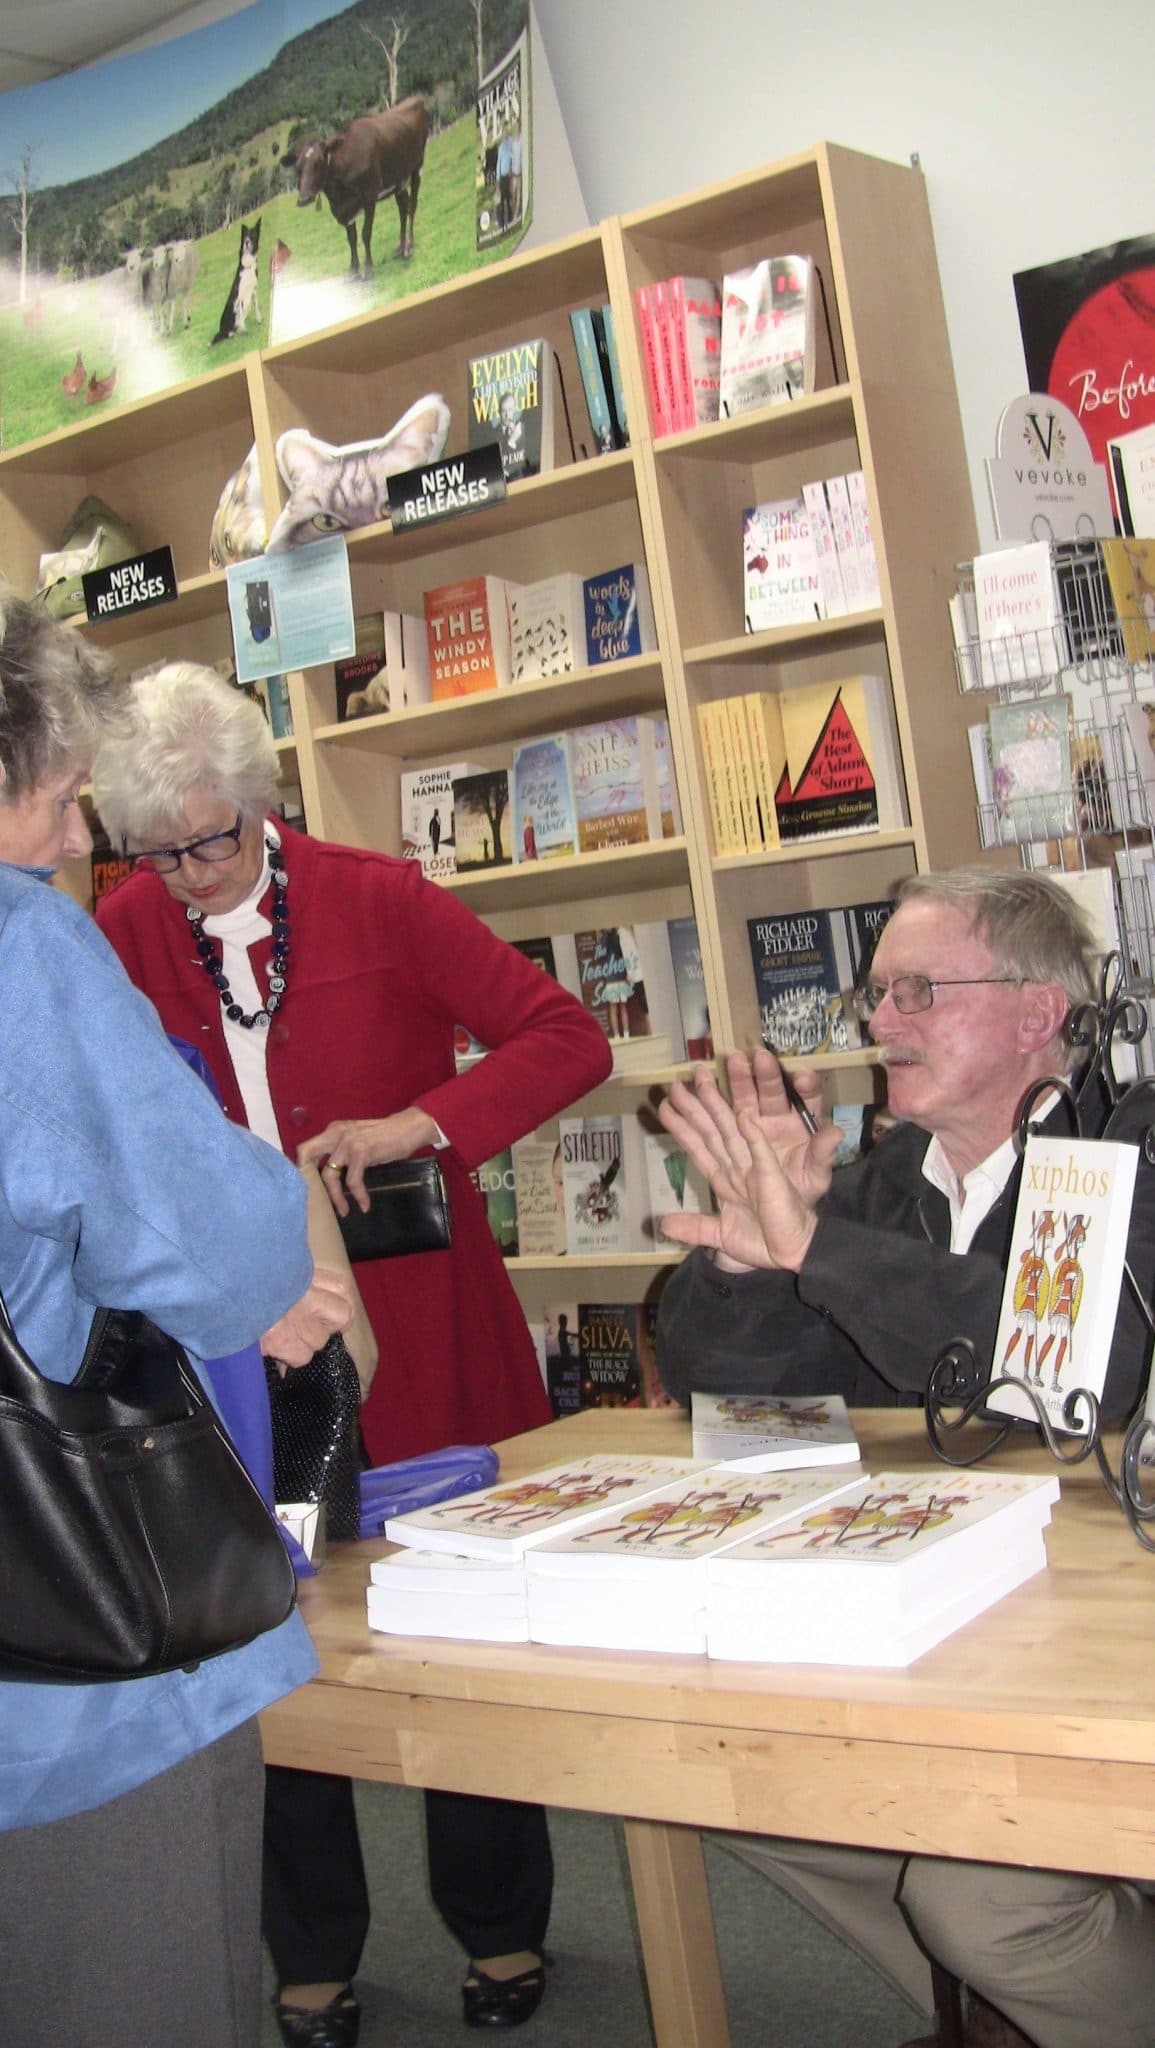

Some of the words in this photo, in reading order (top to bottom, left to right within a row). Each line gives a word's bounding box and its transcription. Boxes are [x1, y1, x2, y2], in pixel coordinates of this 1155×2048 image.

[478, 64, 520, 117] VILLAGE
[478, 90, 520, 168] VETS
[472, 342, 539, 389] EVELYN
[1069, 360, 1155, 420] Before
[472, 380, 539, 424] WAGH
[421, 462, 465, 495] NEW
[1015, 465, 1088, 487] vevoke
[404, 478, 489, 522] RELEASES
[777, 553, 792, 569] IN
[110, 562, 145, 591] NEW
[749, 575, 819, 601] BETWEEN
[96, 576, 165, 615] RELEASES
[588, 577, 632, 600] words
[431, 607, 485, 641] THE
[591, 616, 625, 638] deep
[434, 638, 488, 662] WINDY
[599, 638, 630, 661] blue
[435, 655, 491, 680] SEASON
[830, 728, 851, 742] The
[824, 744, 852, 758] Best
[580, 754, 632, 777] HEISS
[822, 757, 865, 774] Adam
[418, 771, 451, 785] SOPHIE
[820, 775, 864, 792] Sharp
[412, 783, 454, 798] HANNA
[423, 856, 457, 872] LOSE
[756, 916, 818, 941] RICHARD
[764, 934, 815, 956] FIDLER
[563, 1130, 621, 1164] STILETTO
[1027, 1155, 1110, 1204] xiphos
[581, 1326, 634, 1349] SILVA
[590, 1370, 628, 1384] WIDOW
